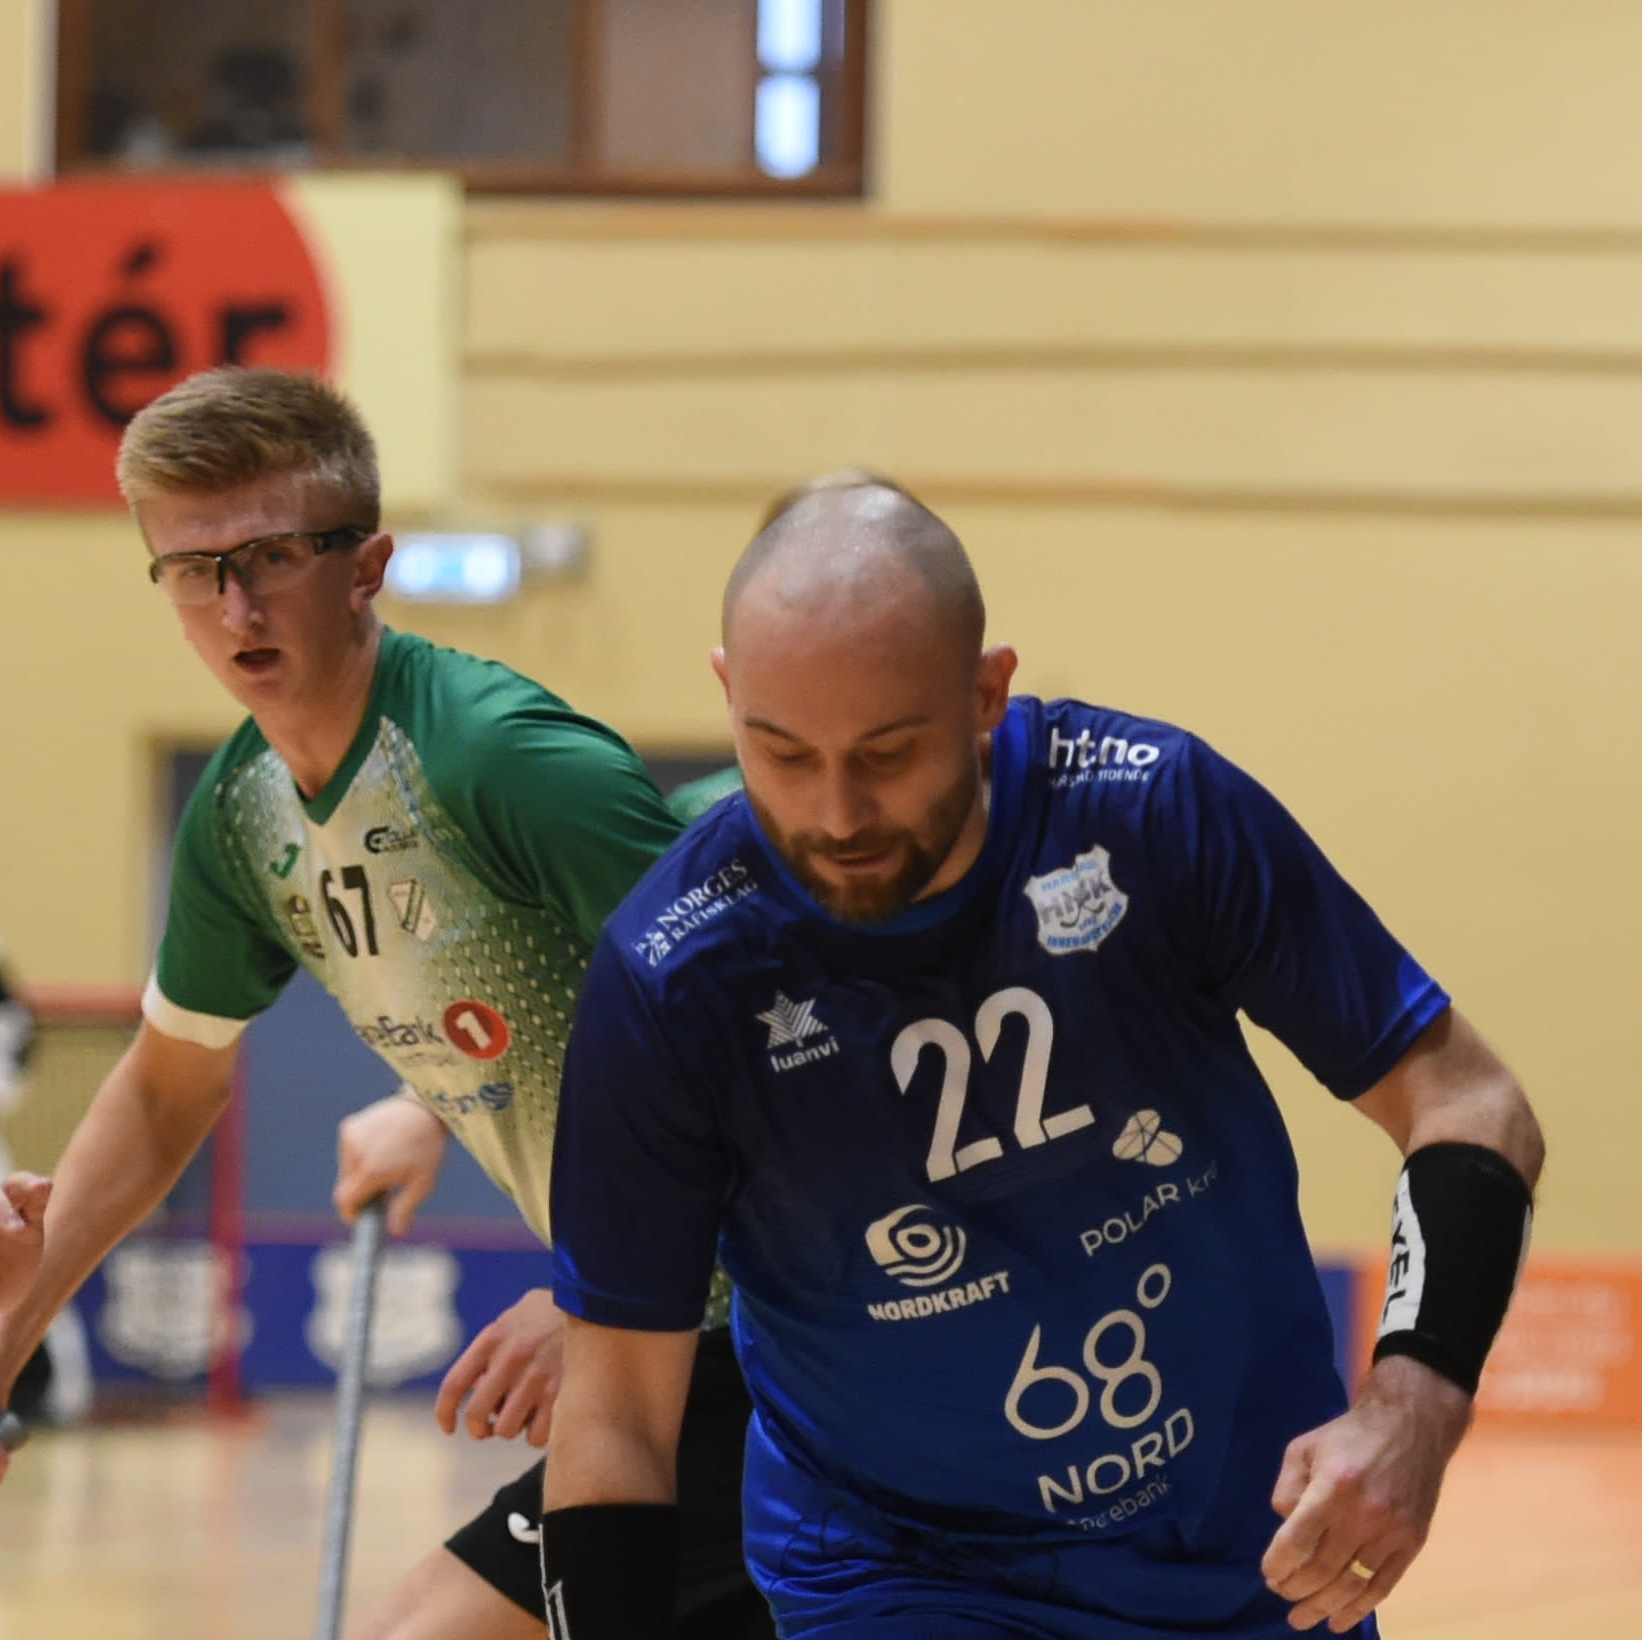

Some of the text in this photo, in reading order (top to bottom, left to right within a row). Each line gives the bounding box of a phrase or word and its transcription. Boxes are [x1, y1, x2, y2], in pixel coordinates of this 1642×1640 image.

[1049, 727, 1160, 769] htno
[321, 865, 379, 958] 67
[657, 859, 747, 930] NORGES
[770, 1035, 839, 1073] luanvi
[890, 986, 1096, 1183] 22
[1079, 1182, 1182, 1257] POLAR
[867, 1270, 1011, 1323] NORDKRAFT
[1037, 1407, 1195, 1515] NORD
